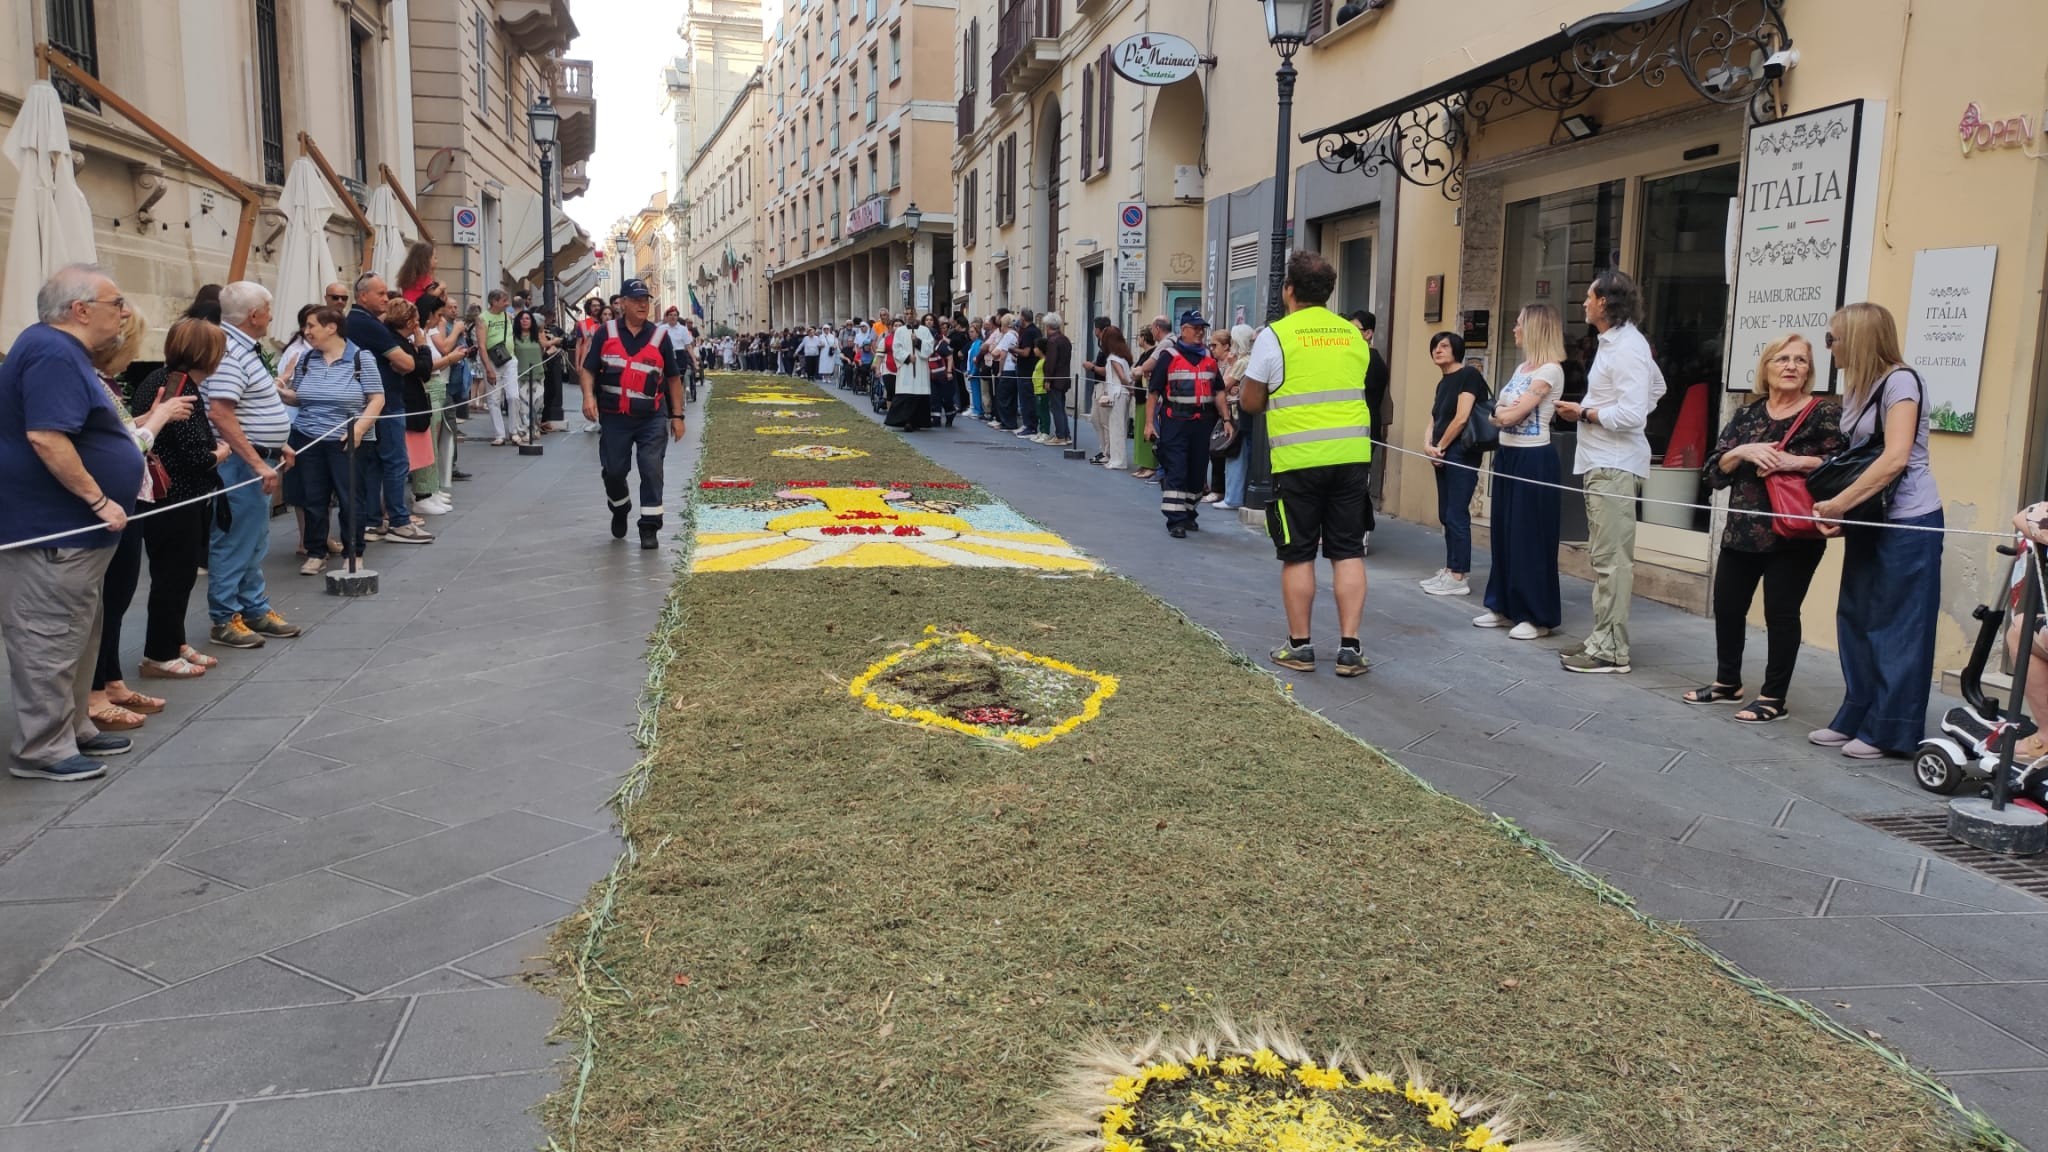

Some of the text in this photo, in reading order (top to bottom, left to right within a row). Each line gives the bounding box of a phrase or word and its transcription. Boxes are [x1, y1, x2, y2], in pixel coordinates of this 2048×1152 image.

[1123, 43, 1197, 68] Pio Marinucci
[1139, 67, 1175, 78] Sartoria
[1977, 114, 2034, 147] OPEN
[1749, 169, 1842, 212] ITALIA
[1748, 286, 1821, 304] HAMBURGERS
[1739, 314, 1771, 330] POKE'
[1779, 312, 1828, 328] PRANZO
[1925, 306, 1968, 320] ITALIA
[1914, 355, 1967, 367] GELATERIA
